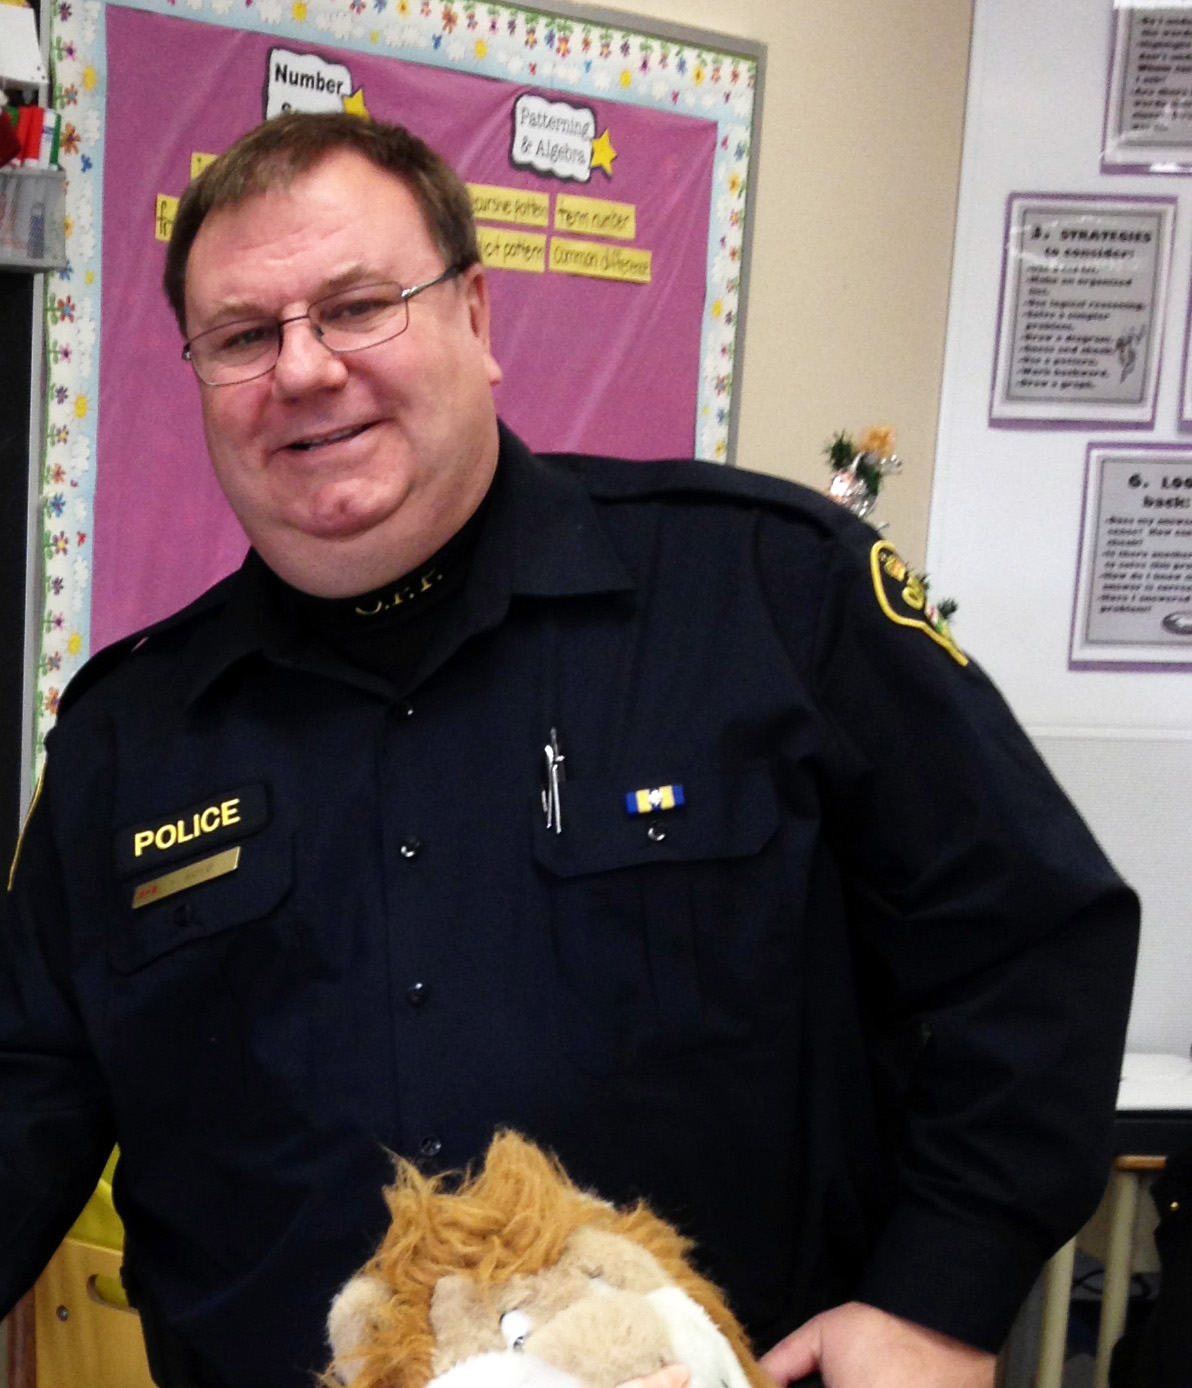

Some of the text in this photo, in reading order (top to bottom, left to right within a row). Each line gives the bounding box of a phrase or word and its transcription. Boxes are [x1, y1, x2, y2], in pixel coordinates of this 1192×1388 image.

[274, 63, 345, 96] Number
[519, 107, 591, 141] Patterning
[535, 138, 588, 167] Algebra
[1061, 229, 1152, 244] STRATEGIES
[1044, 247, 1059, 258] to
[1127, 472, 1192, 491] 6. LOO
[134, 798, 241, 858] POLICE
